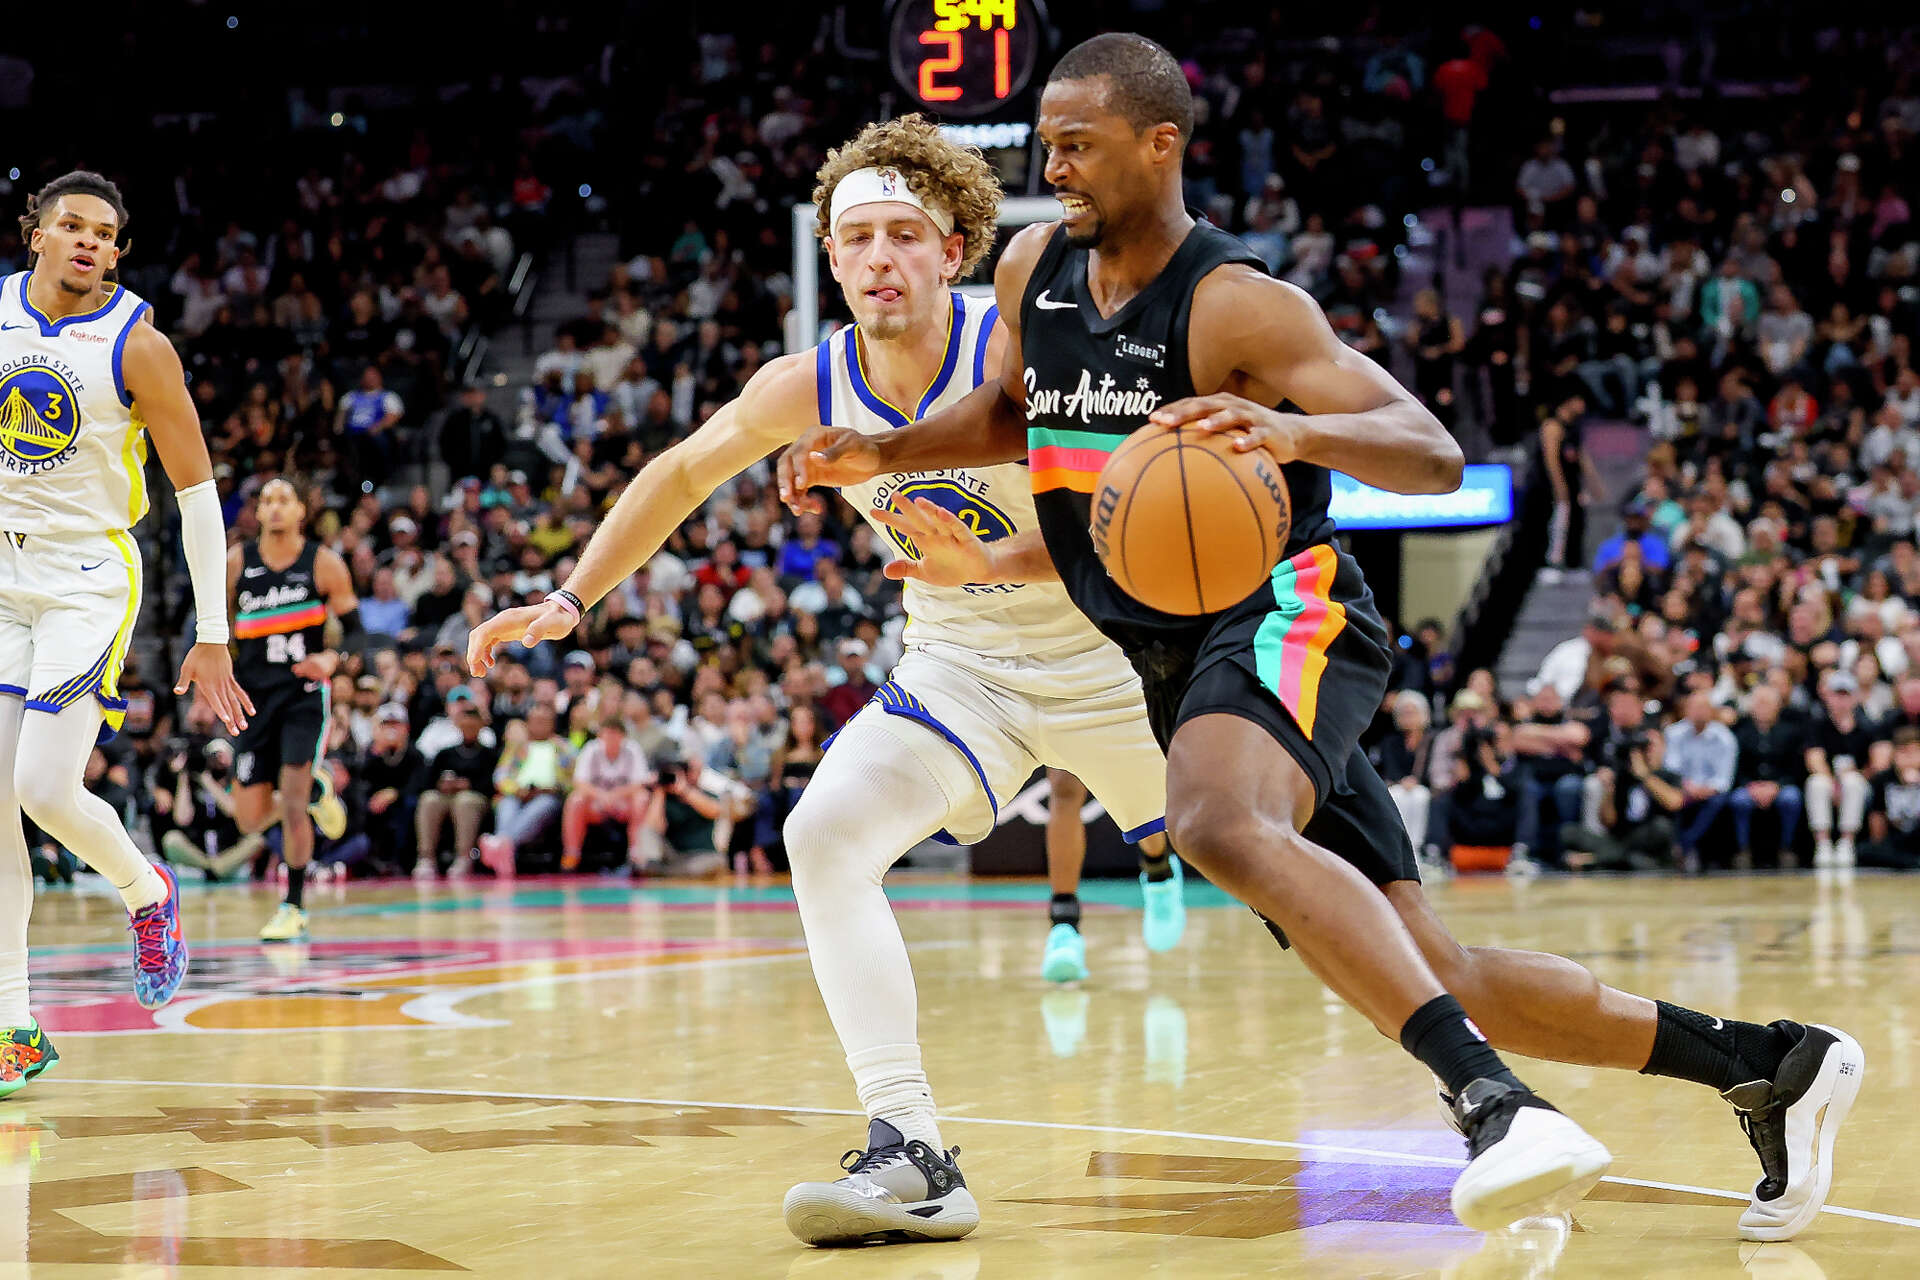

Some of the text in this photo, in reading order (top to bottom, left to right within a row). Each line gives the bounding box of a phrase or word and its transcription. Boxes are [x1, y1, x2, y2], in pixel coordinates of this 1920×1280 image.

[919, 28, 1010, 101] 21
[69, 329, 108, 343] Rakuten
[1122, 341, 1158, 360] LEDGER
[0, 355, 85, 394] OLDEN STATE
[44, 392, 63, 420] 3
[1023, 366, 1162, 424] San Antonio
[0, 446, 77, 475] ARRIORS
